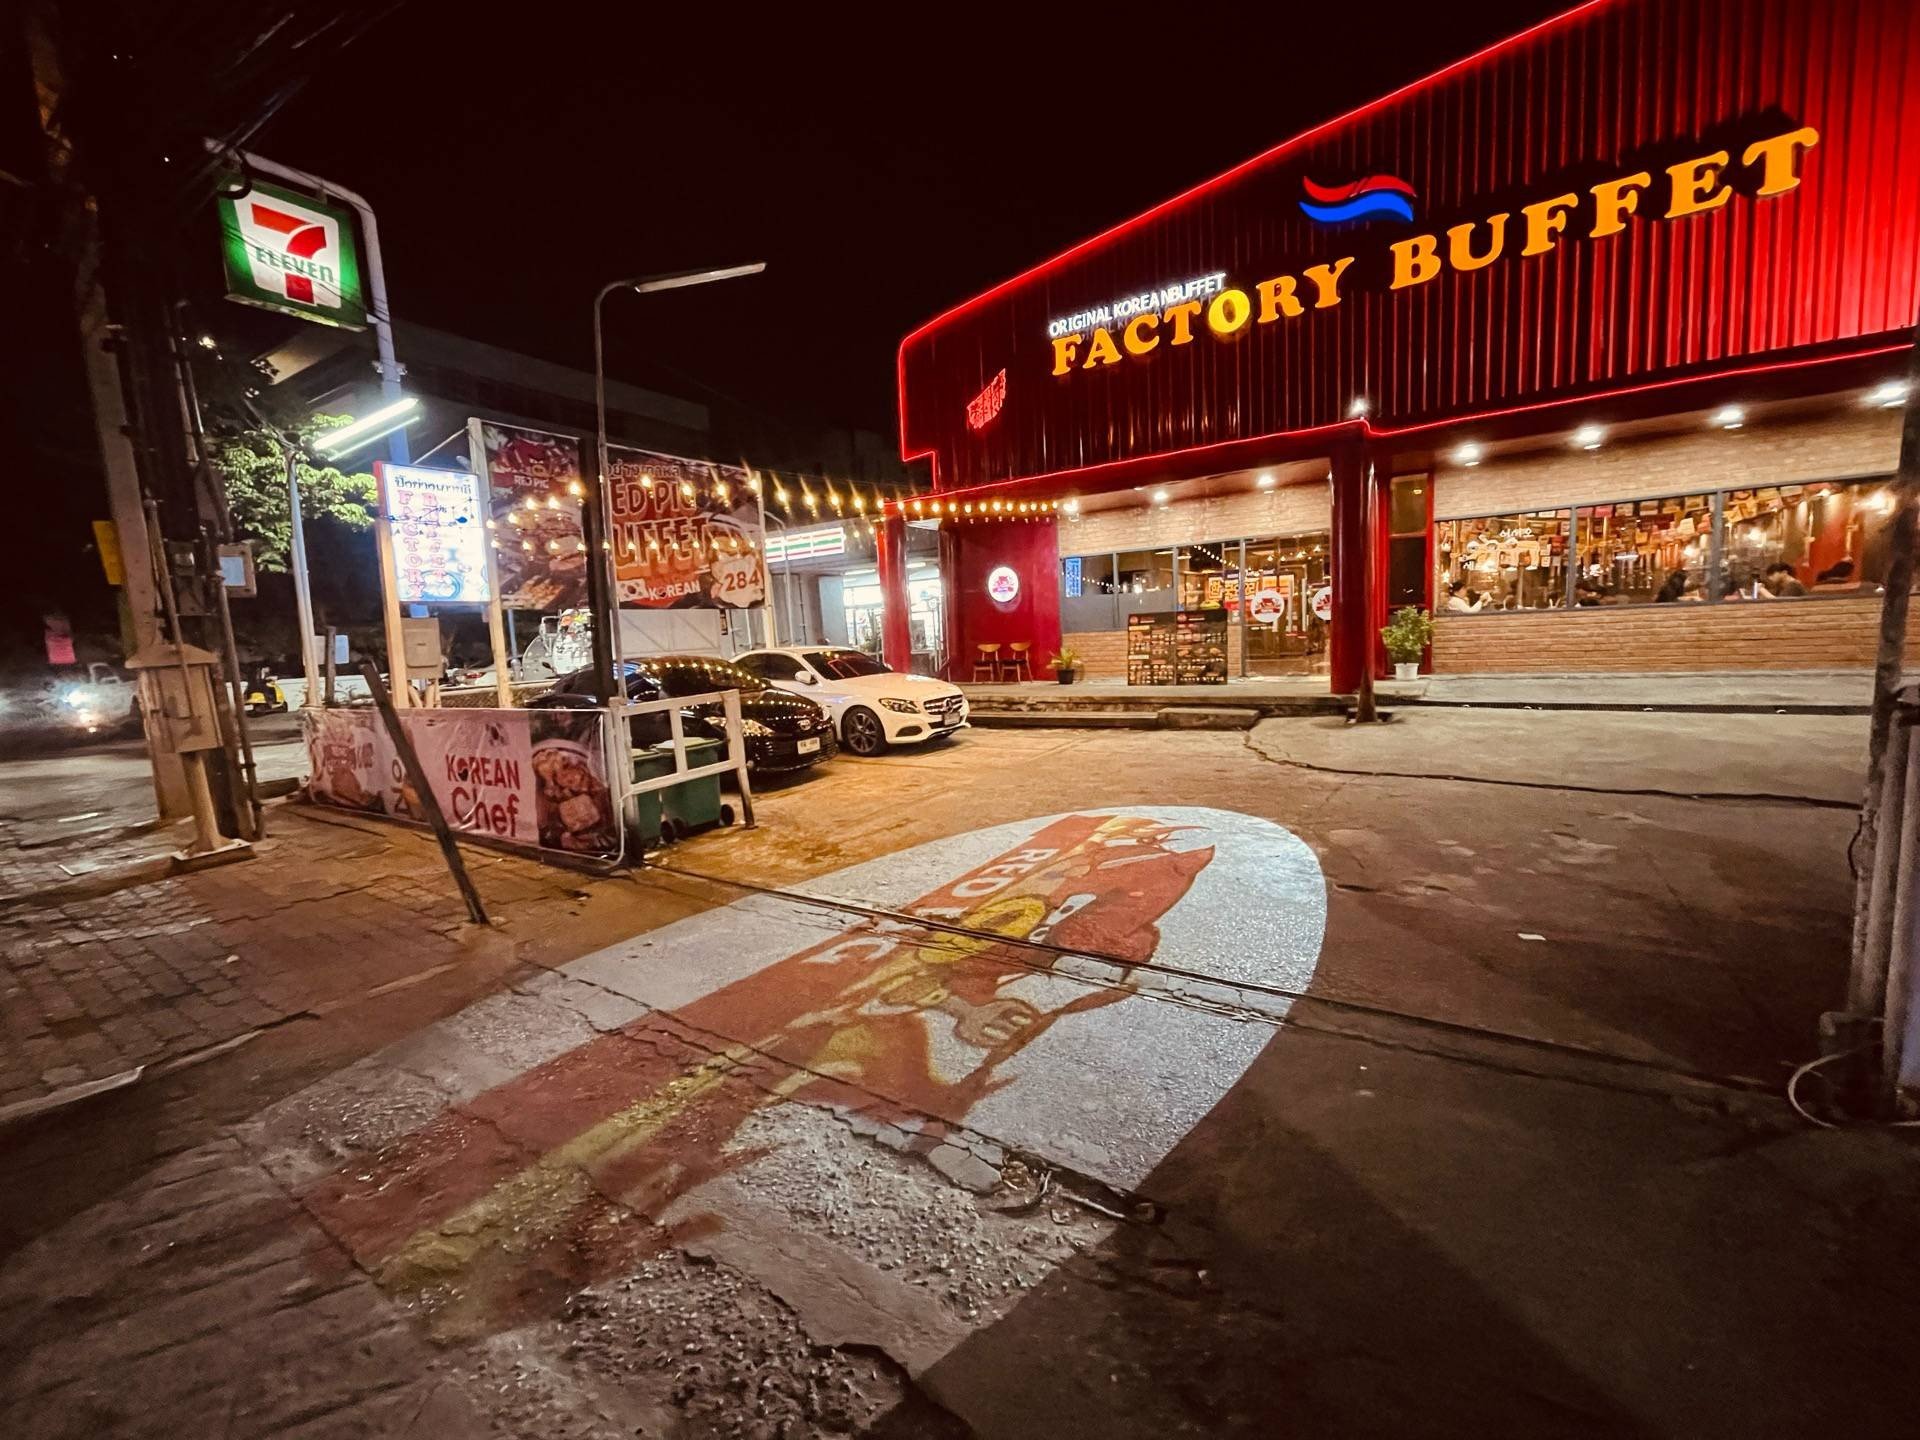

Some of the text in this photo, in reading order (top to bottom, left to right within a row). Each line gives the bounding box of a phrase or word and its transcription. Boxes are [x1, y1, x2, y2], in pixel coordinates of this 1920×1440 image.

[250, 202, 327, 304] 7
[1051, 126, 1820, 376] FACTORY BUFFET
[1049, 306, 1113, 337] ORIGINAL
[608, 476, 648, 517] ED
[612, 515, 710, 568] UFFET
[724, 569, 761, 592] 284
[452, 786, 520, 837] Chef
[951, 848, 1060, 898] RED
